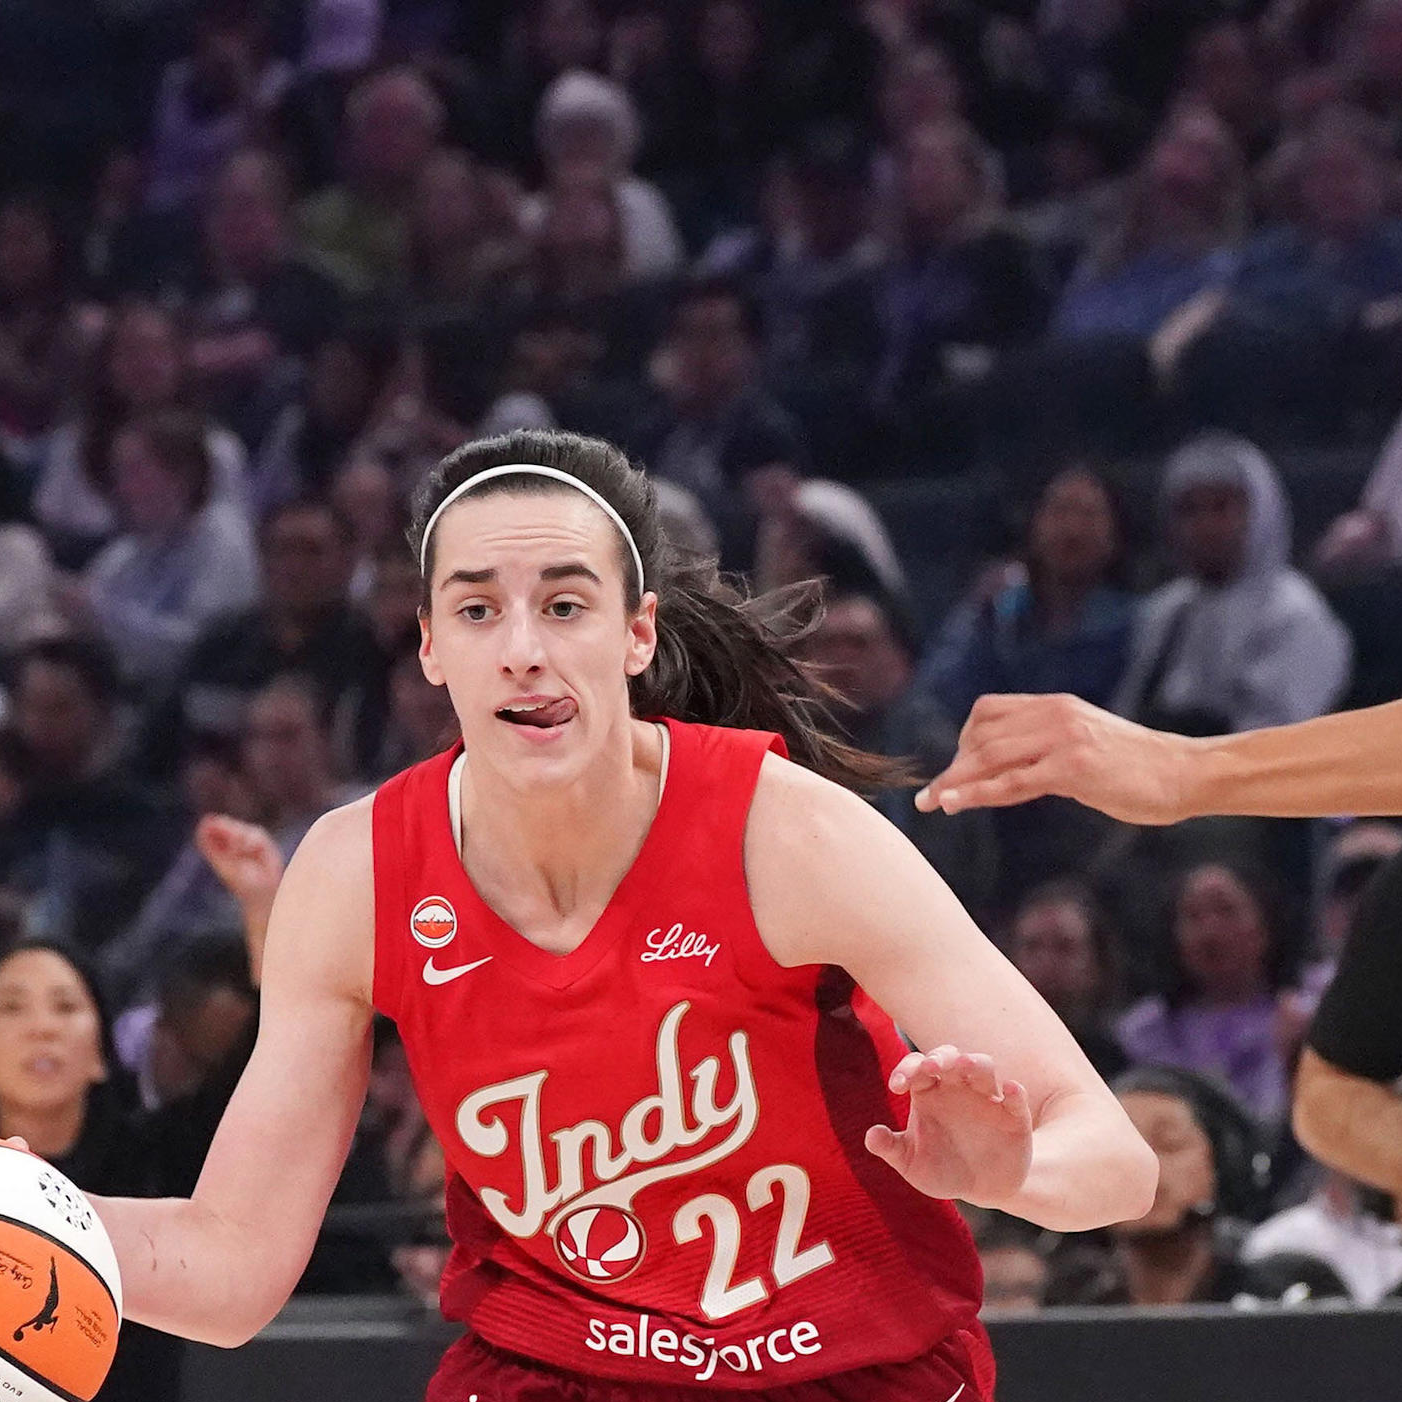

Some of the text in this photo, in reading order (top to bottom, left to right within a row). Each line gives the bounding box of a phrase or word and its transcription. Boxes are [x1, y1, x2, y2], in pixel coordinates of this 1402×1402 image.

[640, 923, 721, 968] Lilly
[455, 1000, 760, 1241] Indy
[671, 1163, 836, 1321] 22
[584, 1314, 823, 1382] salesforce
[1, 1381, 24, 1397] EVO
